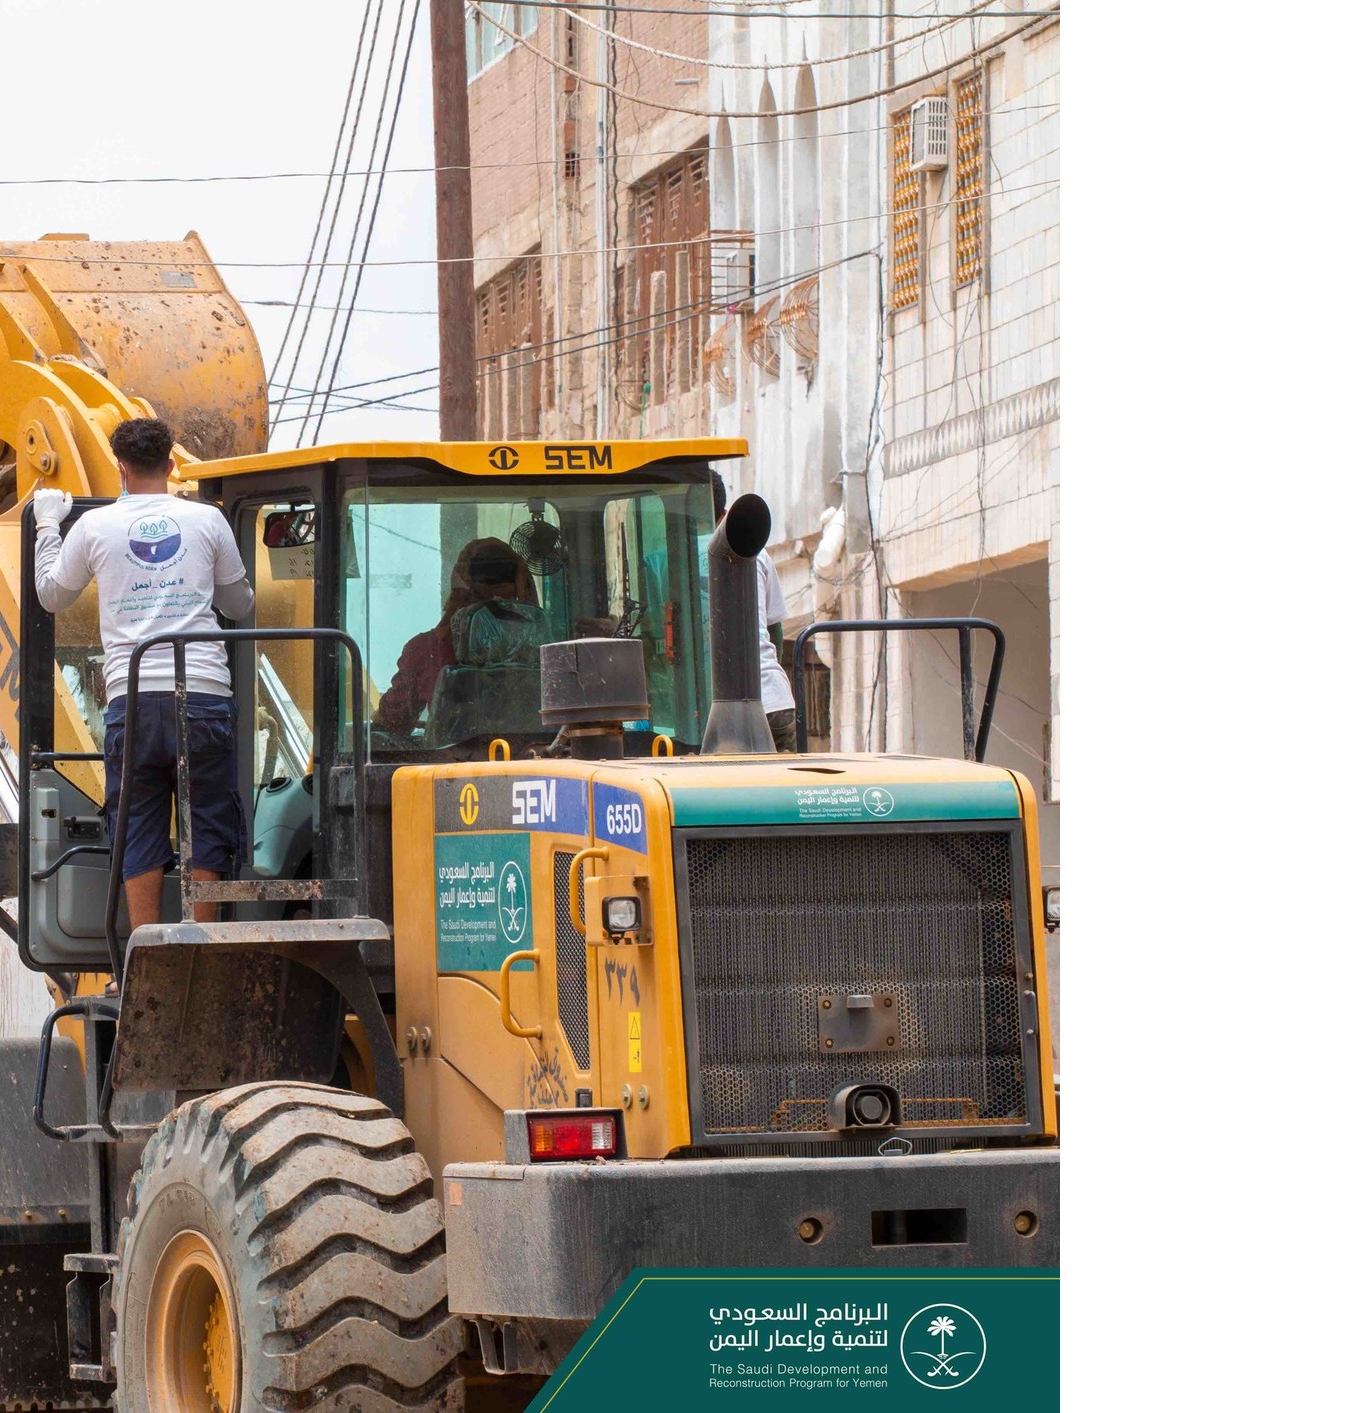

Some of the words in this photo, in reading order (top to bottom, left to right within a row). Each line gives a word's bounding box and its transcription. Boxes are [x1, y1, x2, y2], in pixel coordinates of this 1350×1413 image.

[544, 445, 613, 470] SEM
[159, 580, 177, 588] عدن
[512, 779, 556, 824] SEM
[606, 803, 642, 834] 655D
[439, 861, 469, 884] السعودي
[471, 861, 495, 885] البرنامج
[440, 887, 455, 908] اليمن
[456, 887, 476, 908] وإعمار
[477, 887, 495, 907] لتنمية
[440, 920, 448, 928] The
[449, 920, 460, 929] Saudi
[461, 920, 487, 931] Development
[488, 920, 496, 929] and
[465, 933, 479, 943] Program
[485, 933, 497, 942] Yemen
